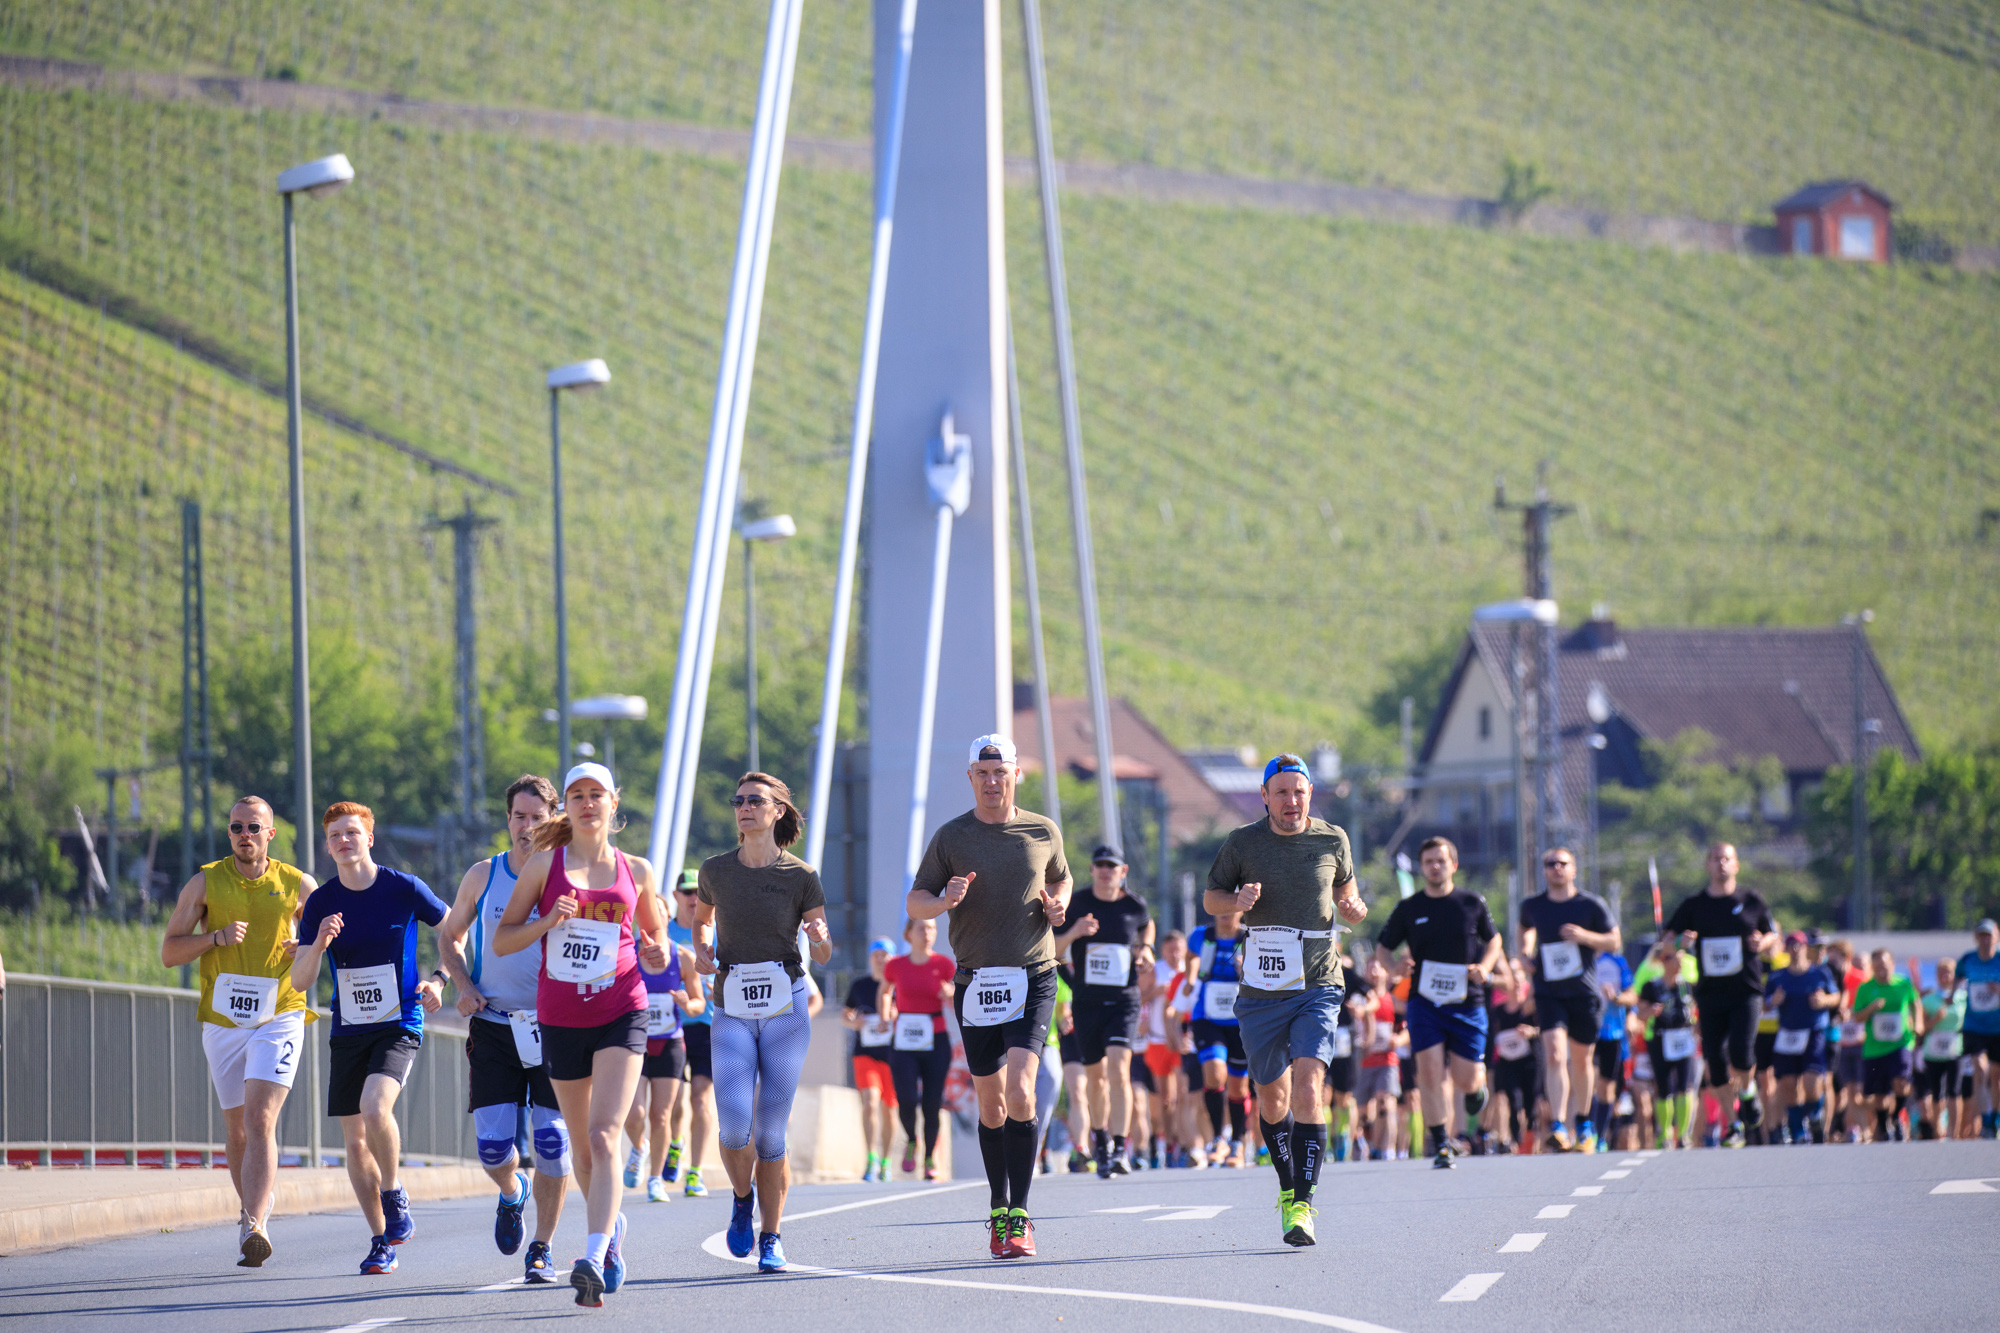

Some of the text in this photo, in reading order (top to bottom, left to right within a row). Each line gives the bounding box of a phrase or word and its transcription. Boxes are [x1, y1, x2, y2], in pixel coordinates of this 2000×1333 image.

[562, 942, 600, 962] 2057
[571, 961, 587, 969] Marie
[1258, 955, 1286, 971] 1875
[352, 988, 382, 1004] 1928
[741, 984, 772, 1001] 1877
[977, 989, 1012, 1005] 1864
[229, 996, 259, 1011] 1491
[747, 1001, 769, 1009] Claudia
[279, 1040, 293, 1065] 2
[1272, 1131, 1289, 1162] alenji
[1303, 1140, 1320, 1180] alenji
